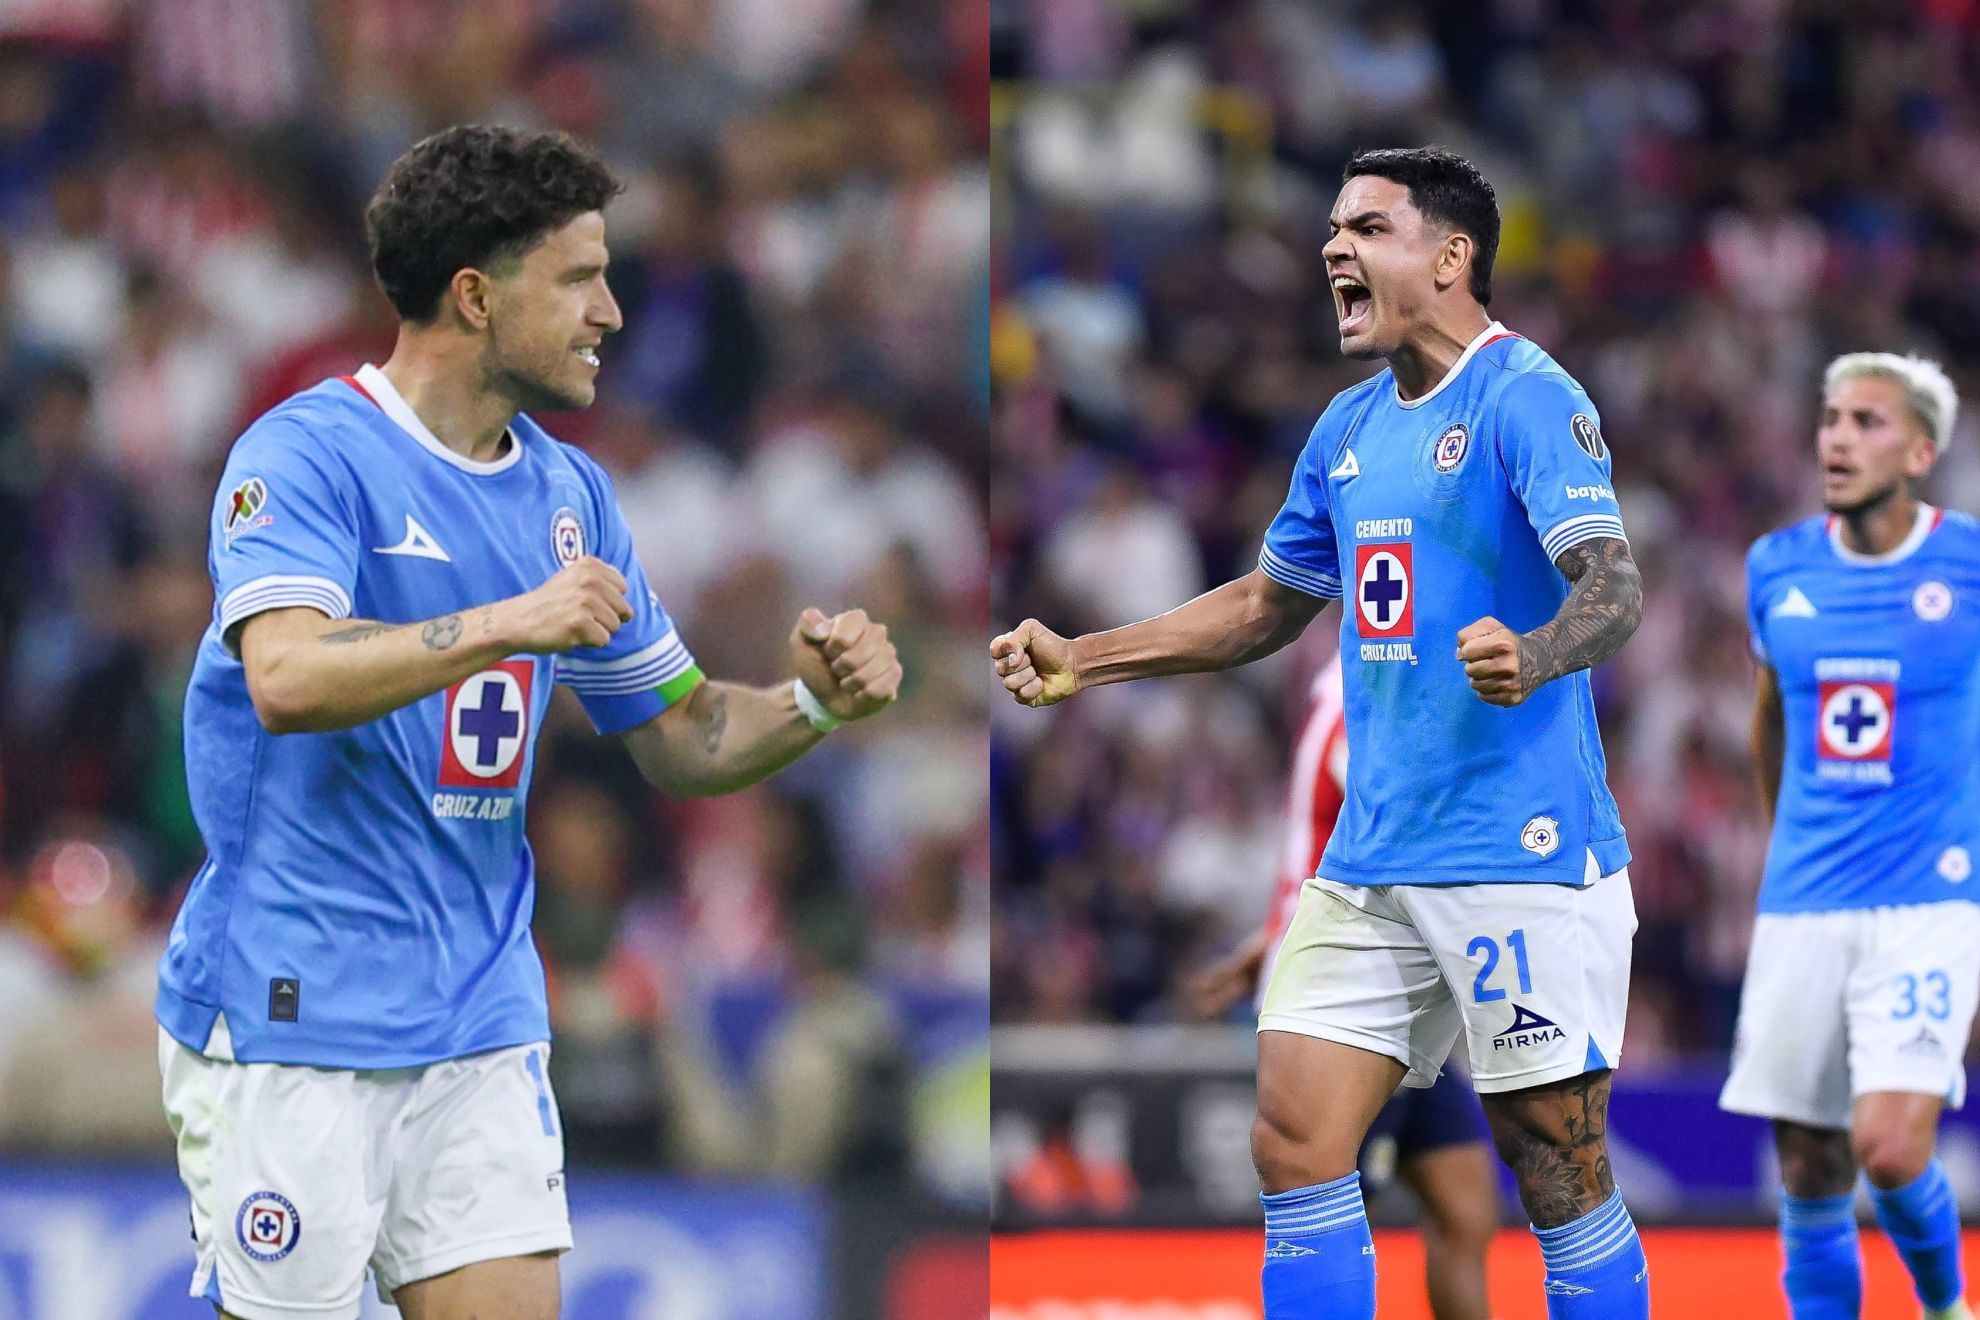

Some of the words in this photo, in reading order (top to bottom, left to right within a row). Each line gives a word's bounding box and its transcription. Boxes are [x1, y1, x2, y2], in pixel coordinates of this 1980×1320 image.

[1356, 517, 1412, 539] CEMENTO
[1361, 644, 1385, 661] CRUZ
[1387, 643, 1417, 661] AZUL
[433, 793, 479, 818] CRUZ
[1466, 928, 1532, 1003] 21
[1890, 969, 1950, 1021] 33
[1493, 1026, 1566, 1051] PIRMA
